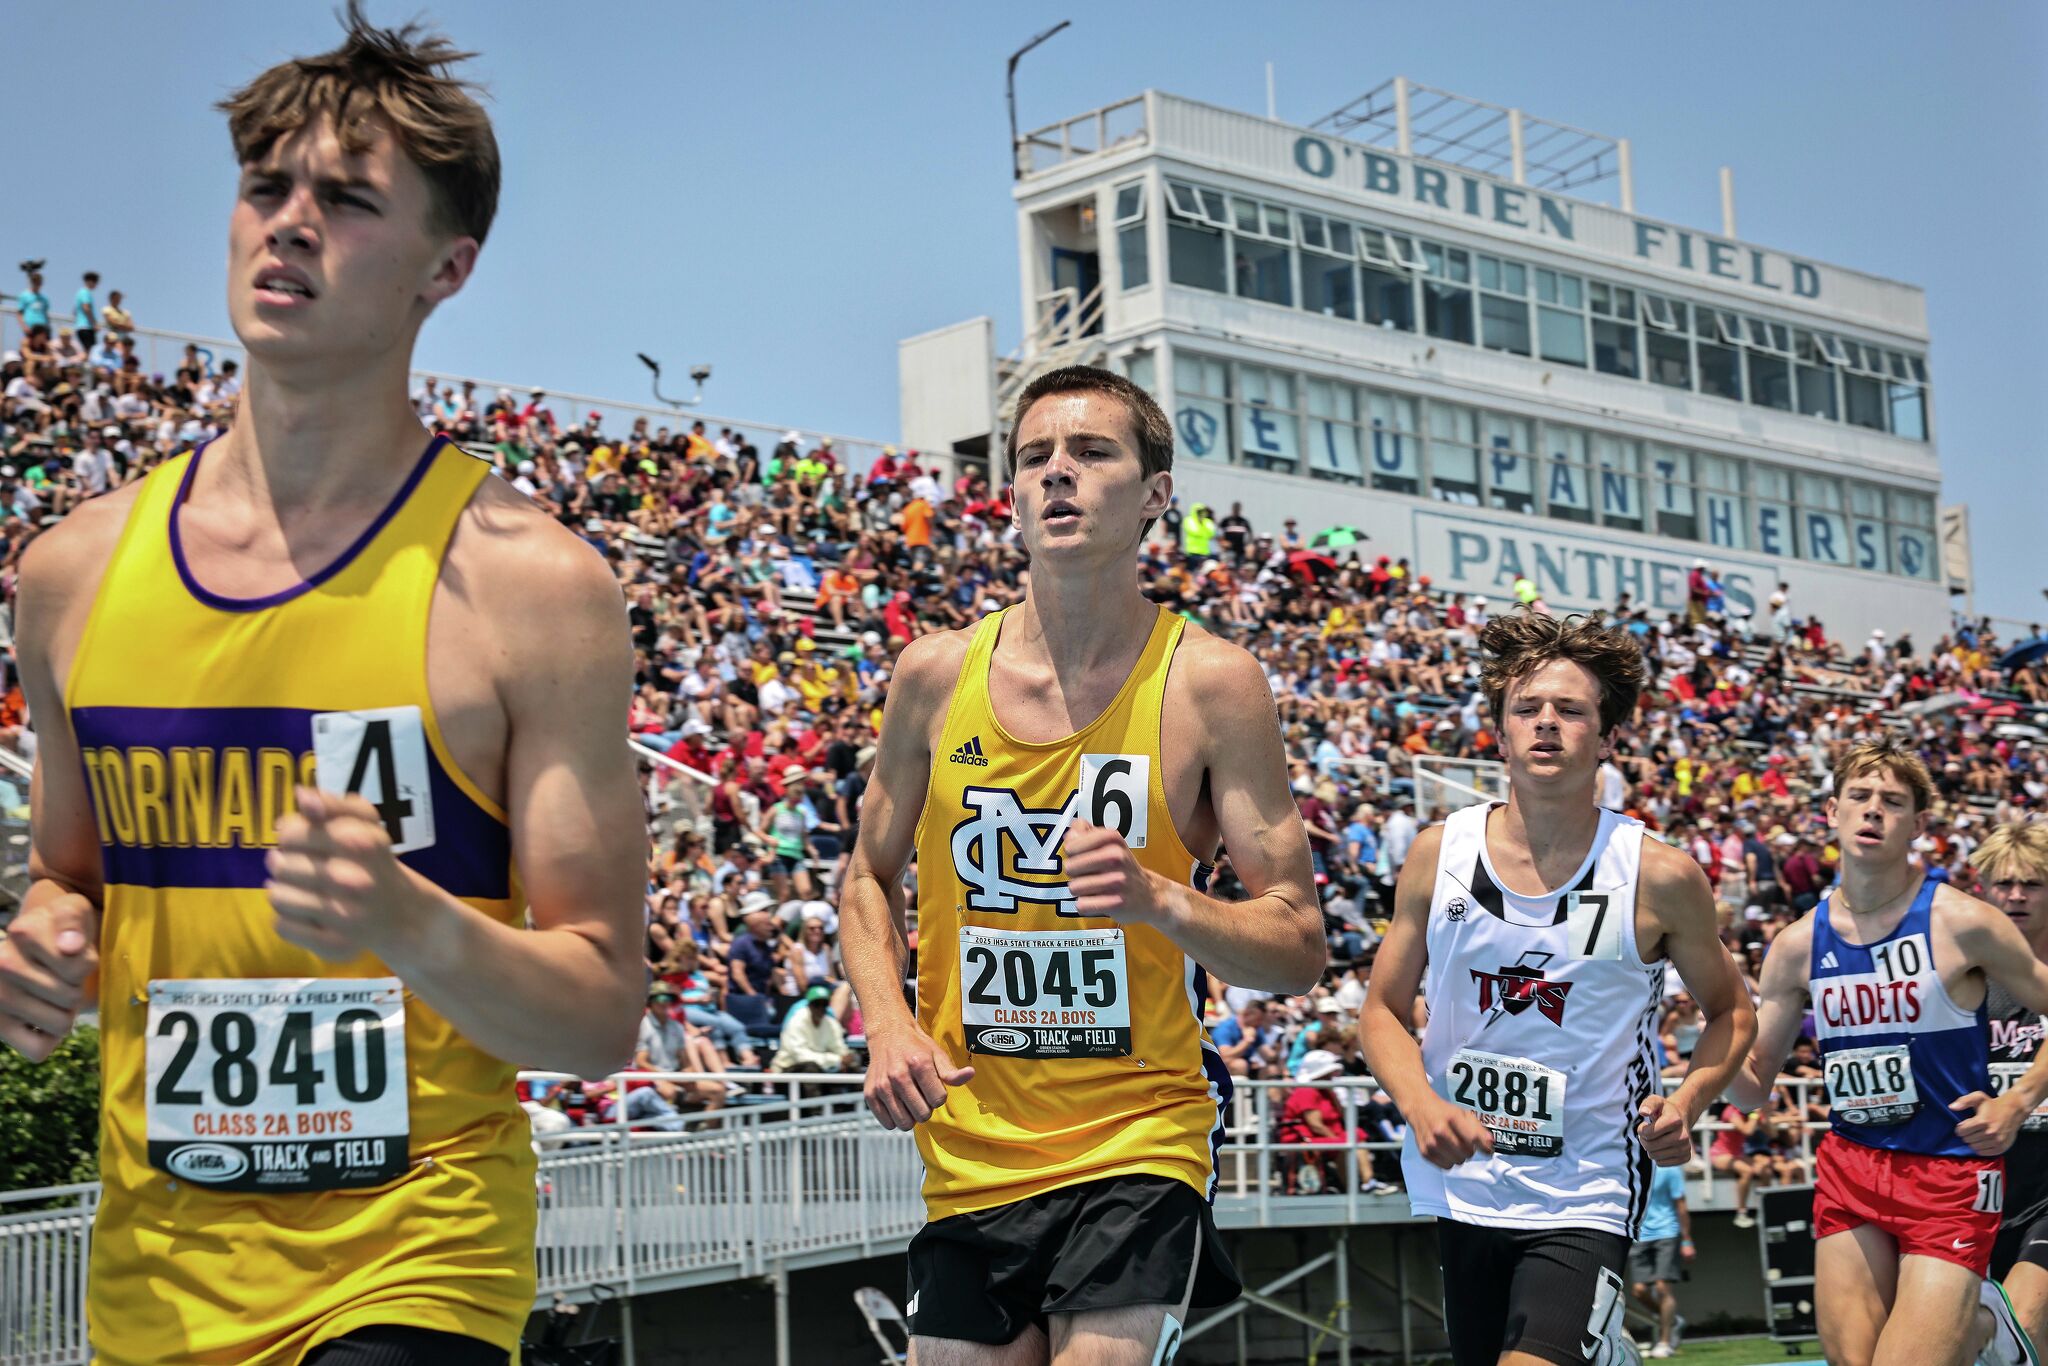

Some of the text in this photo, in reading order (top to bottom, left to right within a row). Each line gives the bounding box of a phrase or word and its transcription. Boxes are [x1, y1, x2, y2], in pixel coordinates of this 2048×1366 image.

[1294, 136, 1821, 298] O'BRIEN FIELD
[1491, 434, 1877, 570] PANTHERS
[1448, 530, 1757, 619] PANTHES
[950, 752, 989, 767] adidas
[346, 720, 414, 844] 4
[1091, 759, 1132, 839] 6
[975, 937, 991, 945] 2025
[993, 938, 1008, 947] IHSA
[1010, 940, 1030, 948] STATE
[1033, 940, 1054, 948] TRACK
[1064, 939, 1084, 947] FIELD
[1086, 937, 1105, 946] MEET
[1579, 895, 1609, 955] 7
[966, 947, 1117, 1007] 2045
[1877, 940, 1920, 981] 10
[307, 993, 338, 1004] FIELD
[342, 991, 373, 1003] MEET
[994, 1009, 1096, 1025] CLASS 2A BOYS
[1823, 981, 1921, 1028] CADETS
[1033, 1029, 1116, 1045] TRACK AND FIELD
[156, 1009, 388, 1107] 2840
[1829, 1057, 1905, 1097] 2018
[1452, 1062, 1552, 1121] 2881
[193, 1110, 353, 1136] CLASS 2A BOYS
[1492, 1129, 1518, 1146] TRACK
[1528, 1135, 1552, 1148] FIELD
[1499, 1116, 1510, 1128] 2A
[1513, 1119, 1538, 1132] BOYS
[251, 1139, 386, 1171] TRACK AND FIELD
